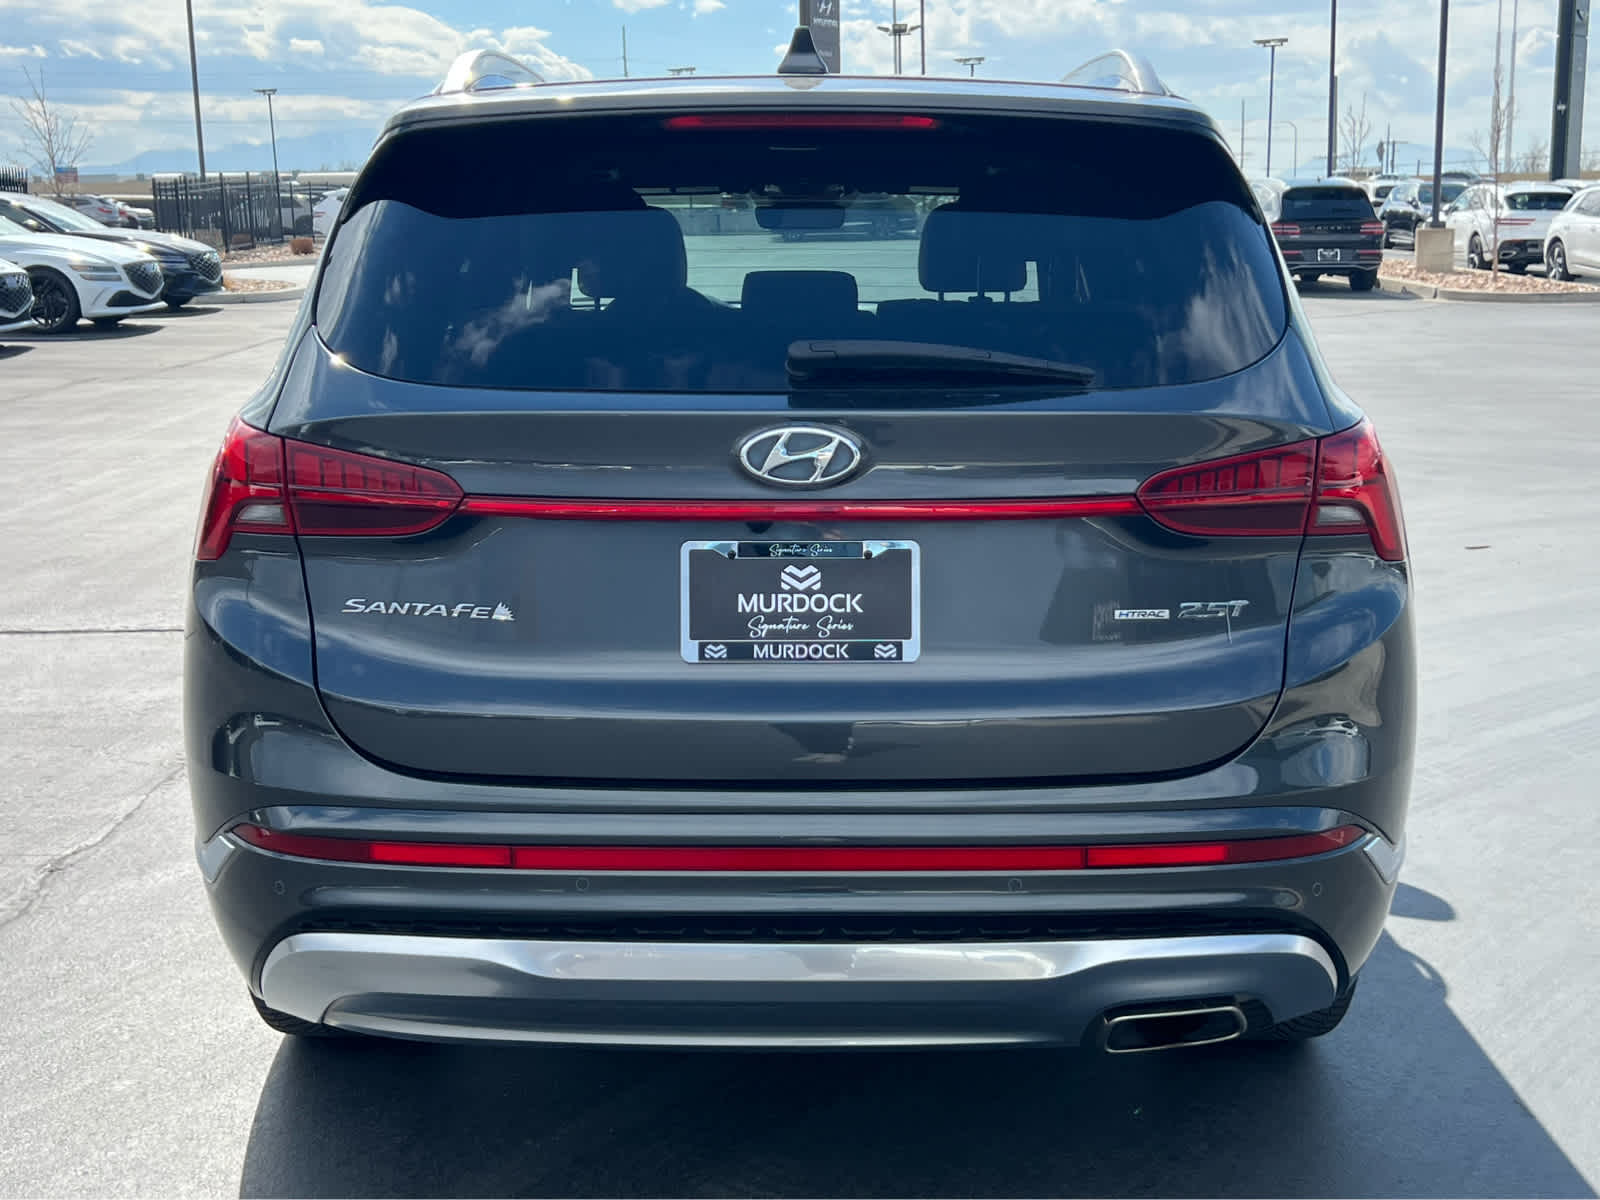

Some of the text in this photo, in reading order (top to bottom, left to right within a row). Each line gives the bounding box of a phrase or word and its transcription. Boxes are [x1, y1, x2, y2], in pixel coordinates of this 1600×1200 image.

[737, 593, 863, 613] MURDOCK
[1118, 609, 1167, 619] HTRAC
[747, 615, 854, 638] Signature Series
[753, 644, 849, 659] MURDOCK
